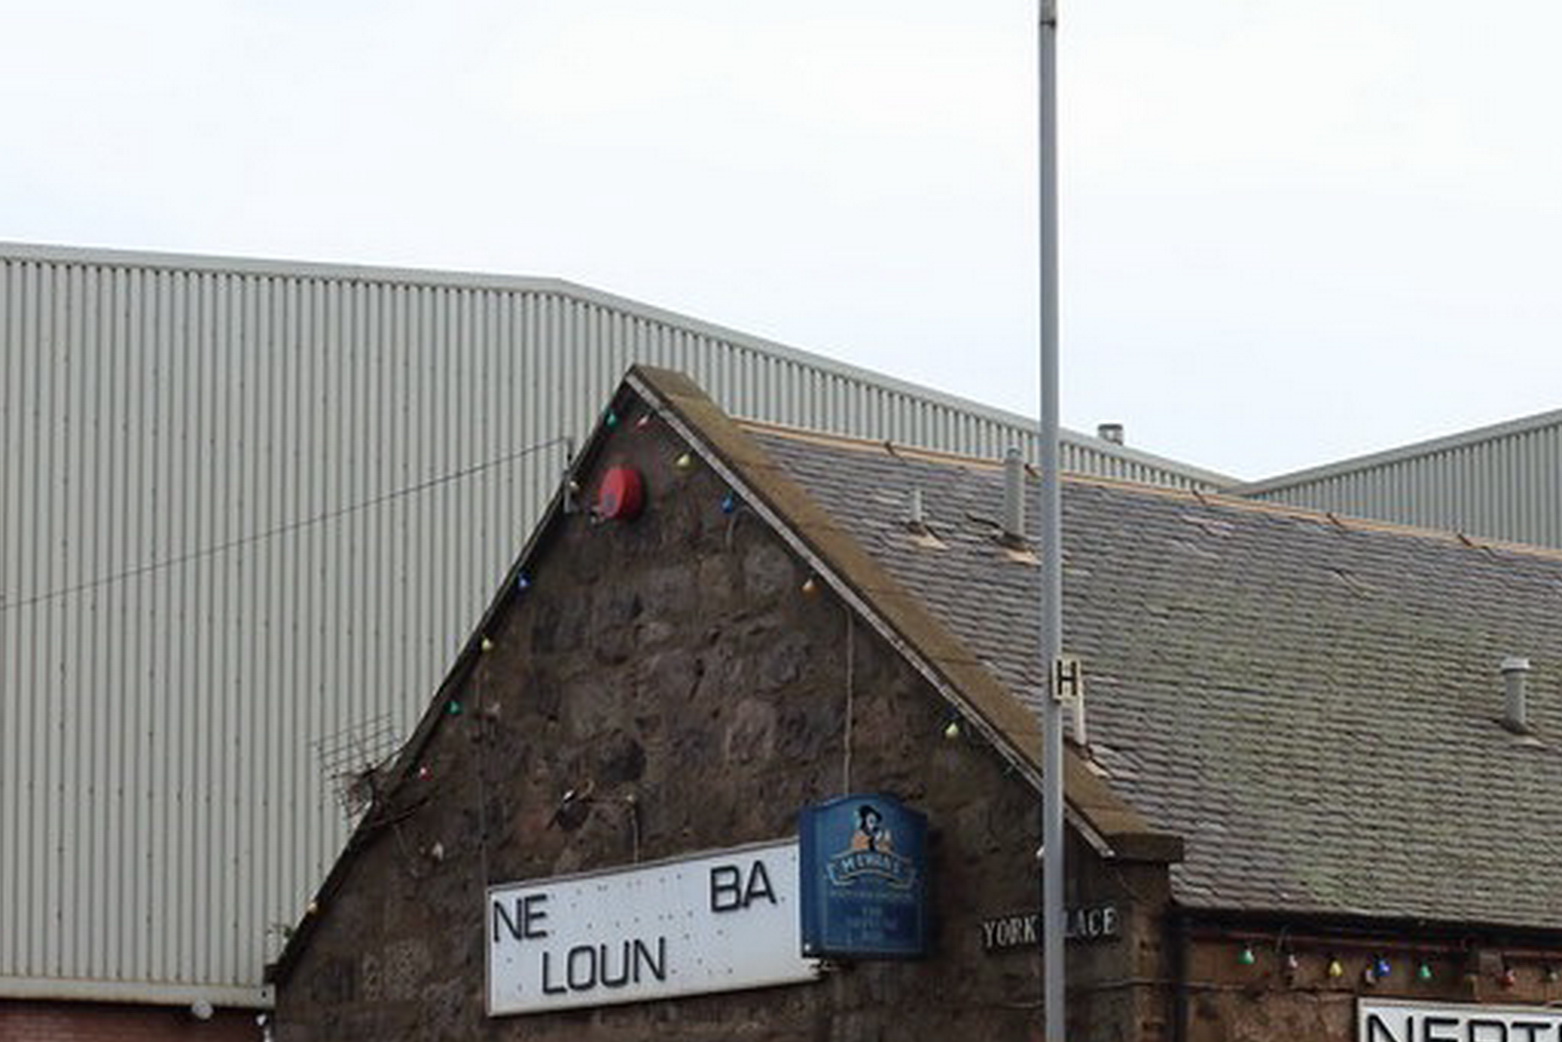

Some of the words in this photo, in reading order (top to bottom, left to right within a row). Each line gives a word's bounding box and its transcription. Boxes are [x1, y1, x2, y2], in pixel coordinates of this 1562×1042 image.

[1057, 660, 1077, 696] H
[492, 893, 548, 943] NE
[709, 859, 778, 914] BA
[982, 914, 1039, 948] YORK
[1063, 906, 1119, 938] LACE
[541, 936, 667, 996] LOUN
